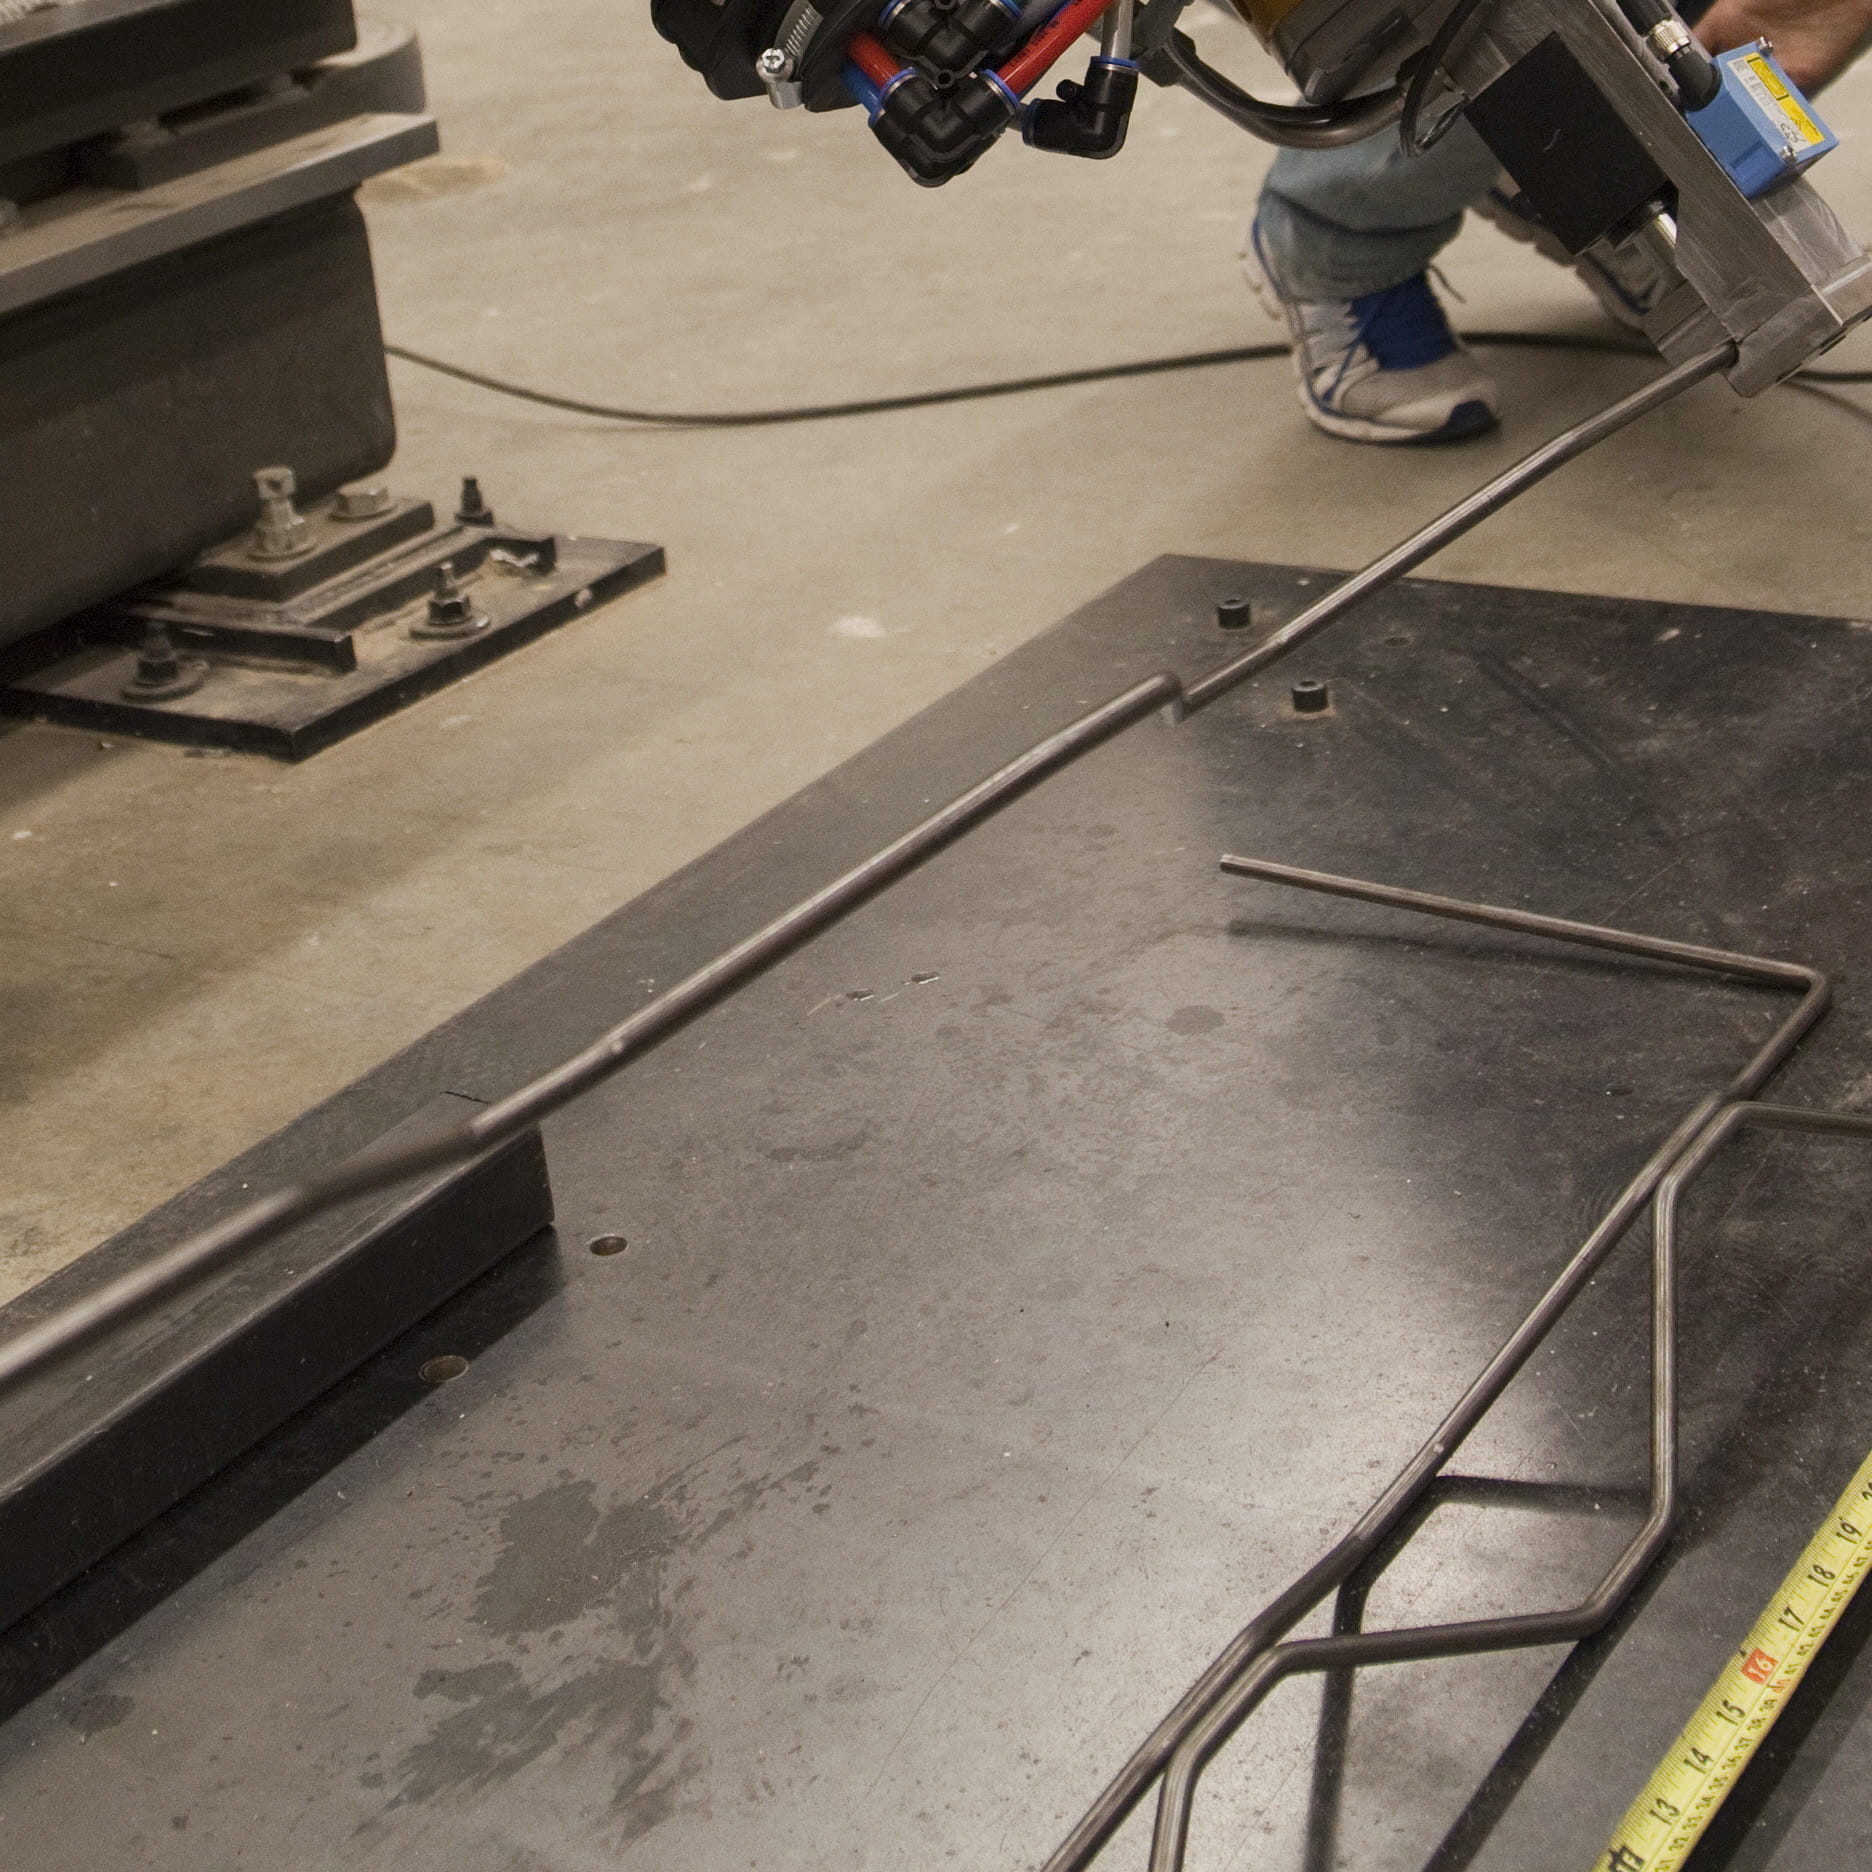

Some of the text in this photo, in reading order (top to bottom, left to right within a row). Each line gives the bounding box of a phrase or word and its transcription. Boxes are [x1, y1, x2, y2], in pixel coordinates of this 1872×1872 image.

[1649, 1797, 1680, 1825] 13
[1683, 1747, 1713, 1774] 14
[1716, 1700, 1745, 1726] 15
[1748, 1656, 1773, 1682] 16
[1778, 1606, 1805, 1632] 17
[1807, 1564, 1836, 1588] 18
[1836, 1521, 1862, 1544] 19
